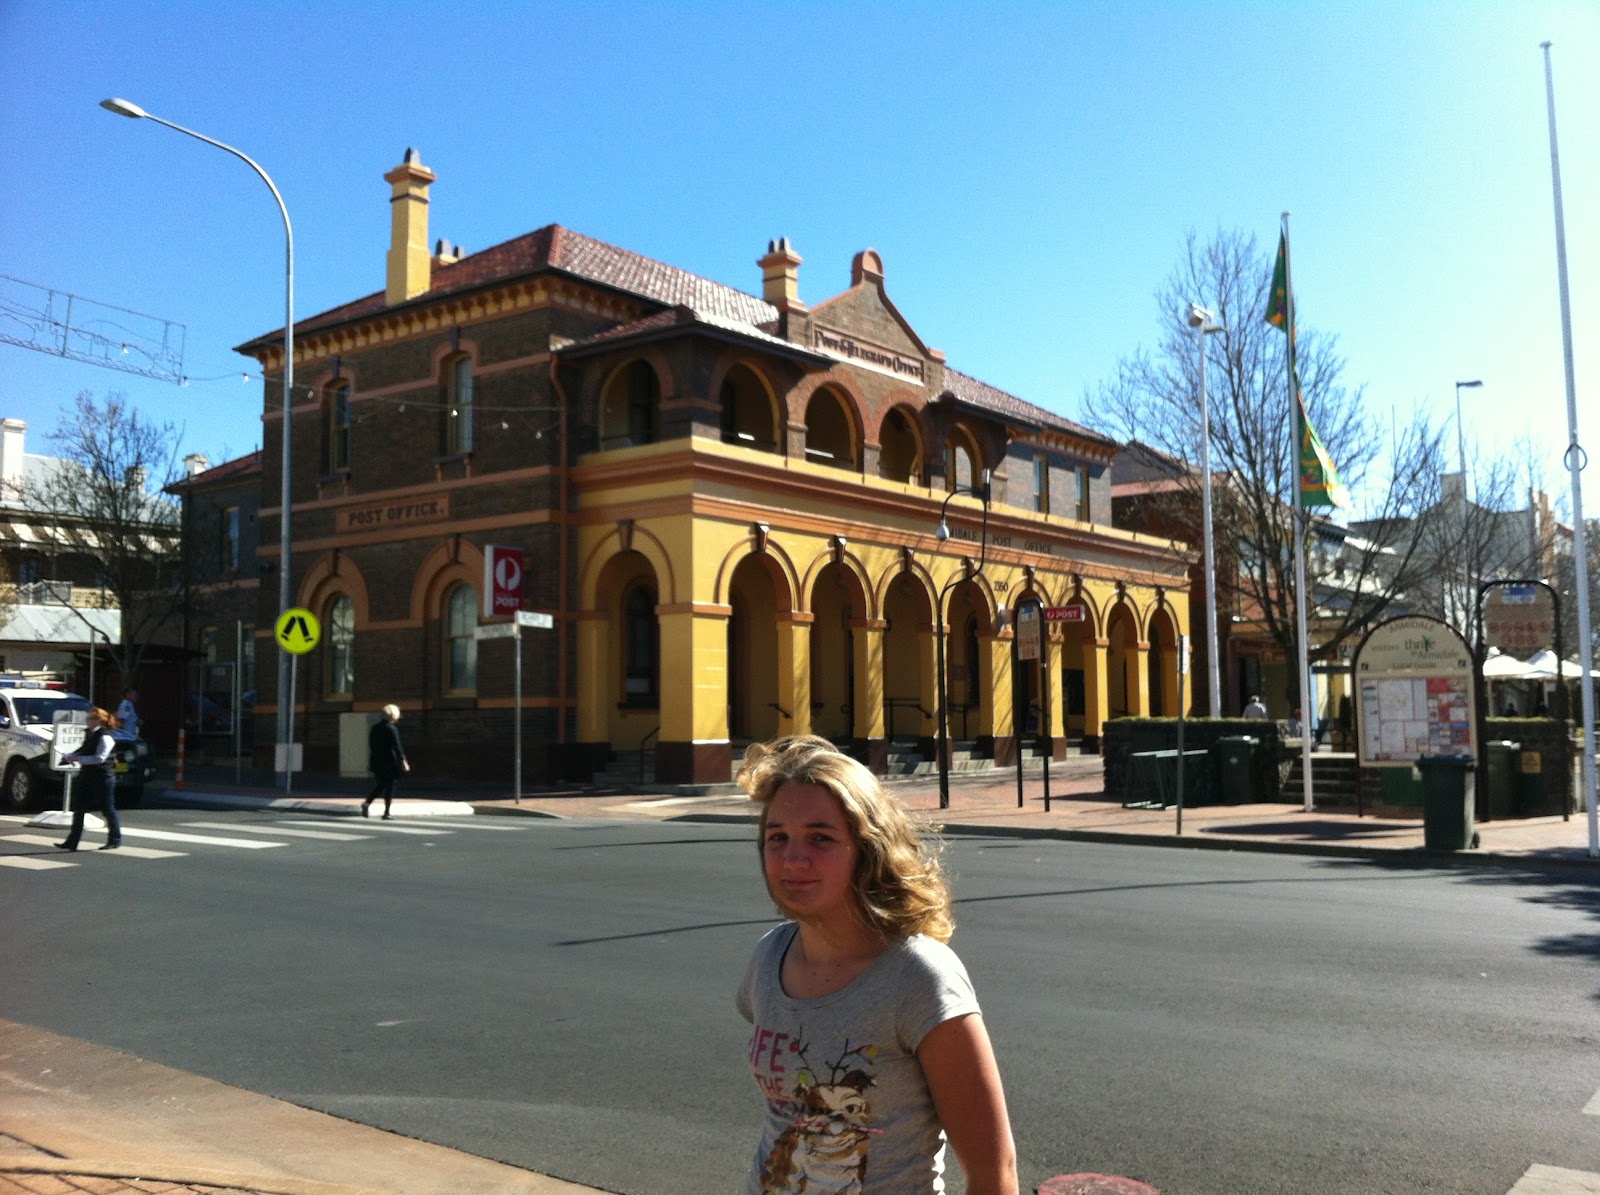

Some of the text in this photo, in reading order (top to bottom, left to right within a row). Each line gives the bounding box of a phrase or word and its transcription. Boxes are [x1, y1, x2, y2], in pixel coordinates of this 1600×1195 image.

[348, 509, 383, 527] POST
[948, 527, 1053, 554] MIDALE POST OFFICE
[495, 596, 520, 607] POST
[1056, 610, 1078, 619] POST
[62, 726, 85, 735] KEEP
[62, 736, 84, 745] LEFT
[748, 1025, 789, 1072] IFE
